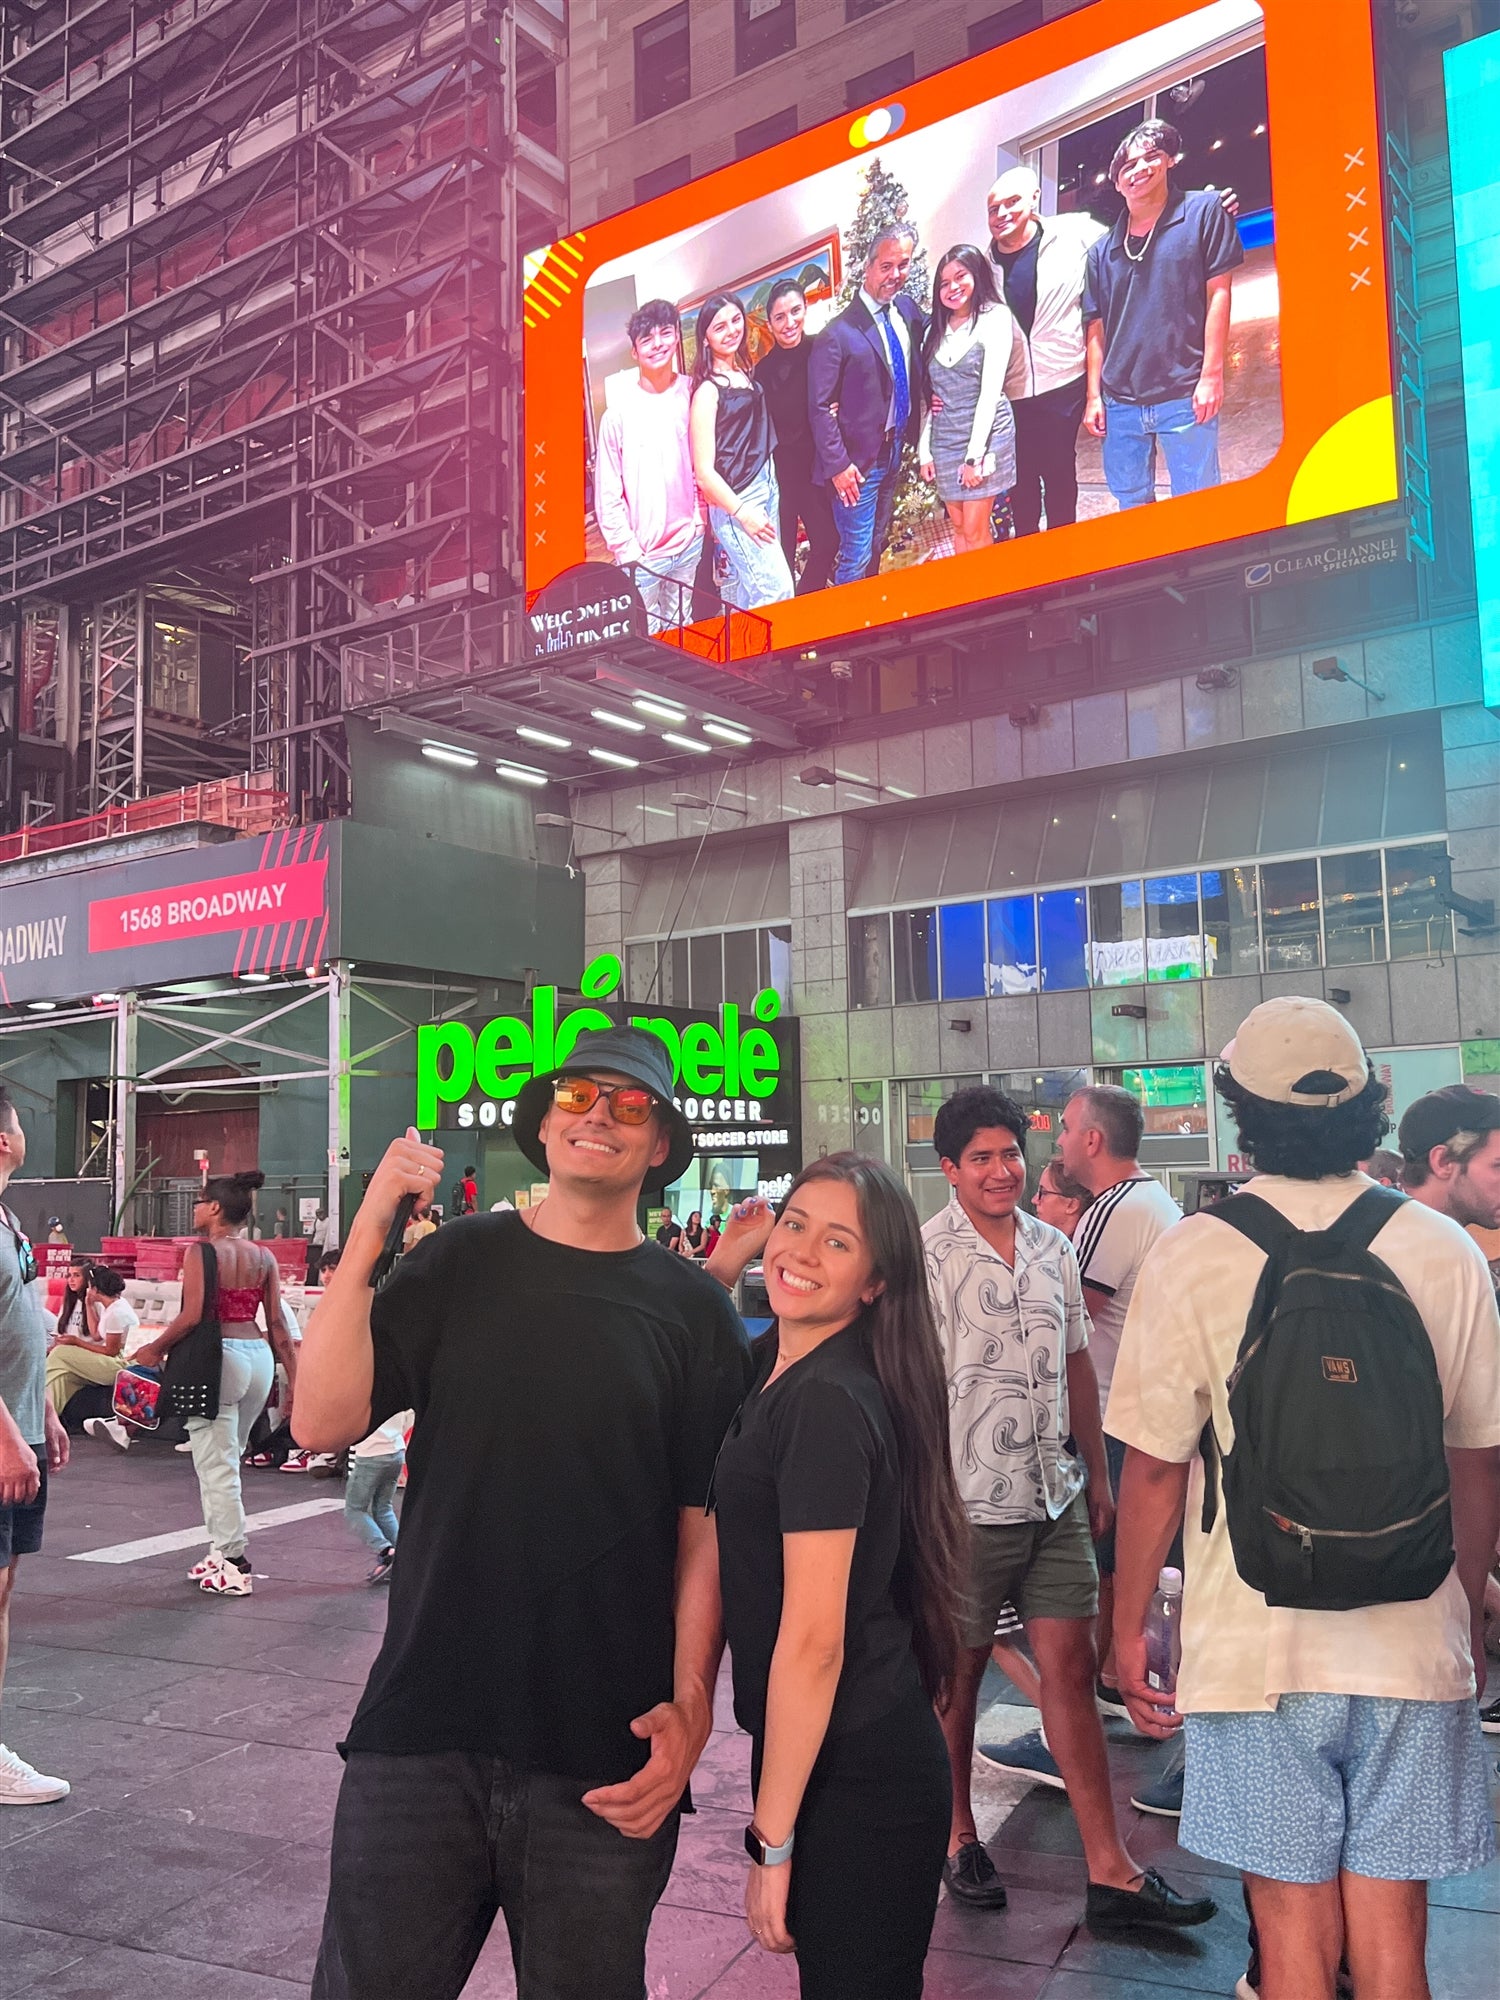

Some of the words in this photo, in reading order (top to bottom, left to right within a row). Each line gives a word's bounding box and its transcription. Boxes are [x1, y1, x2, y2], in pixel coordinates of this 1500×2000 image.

[1323, 549, 1398, 572] SPECTACOLOR
[119, 904, 162, 933] 1568
[167, 882, 288, 926] BROADWAY
[0, 915, 68, 967] ADWAY
[457, 1102, 515, 1128] SOC
[697, 1131, 746, 1147] SOCCER
[747, 1129, 789, 1145] STORE
[1326, 1359, 1350, 1374] VANS
